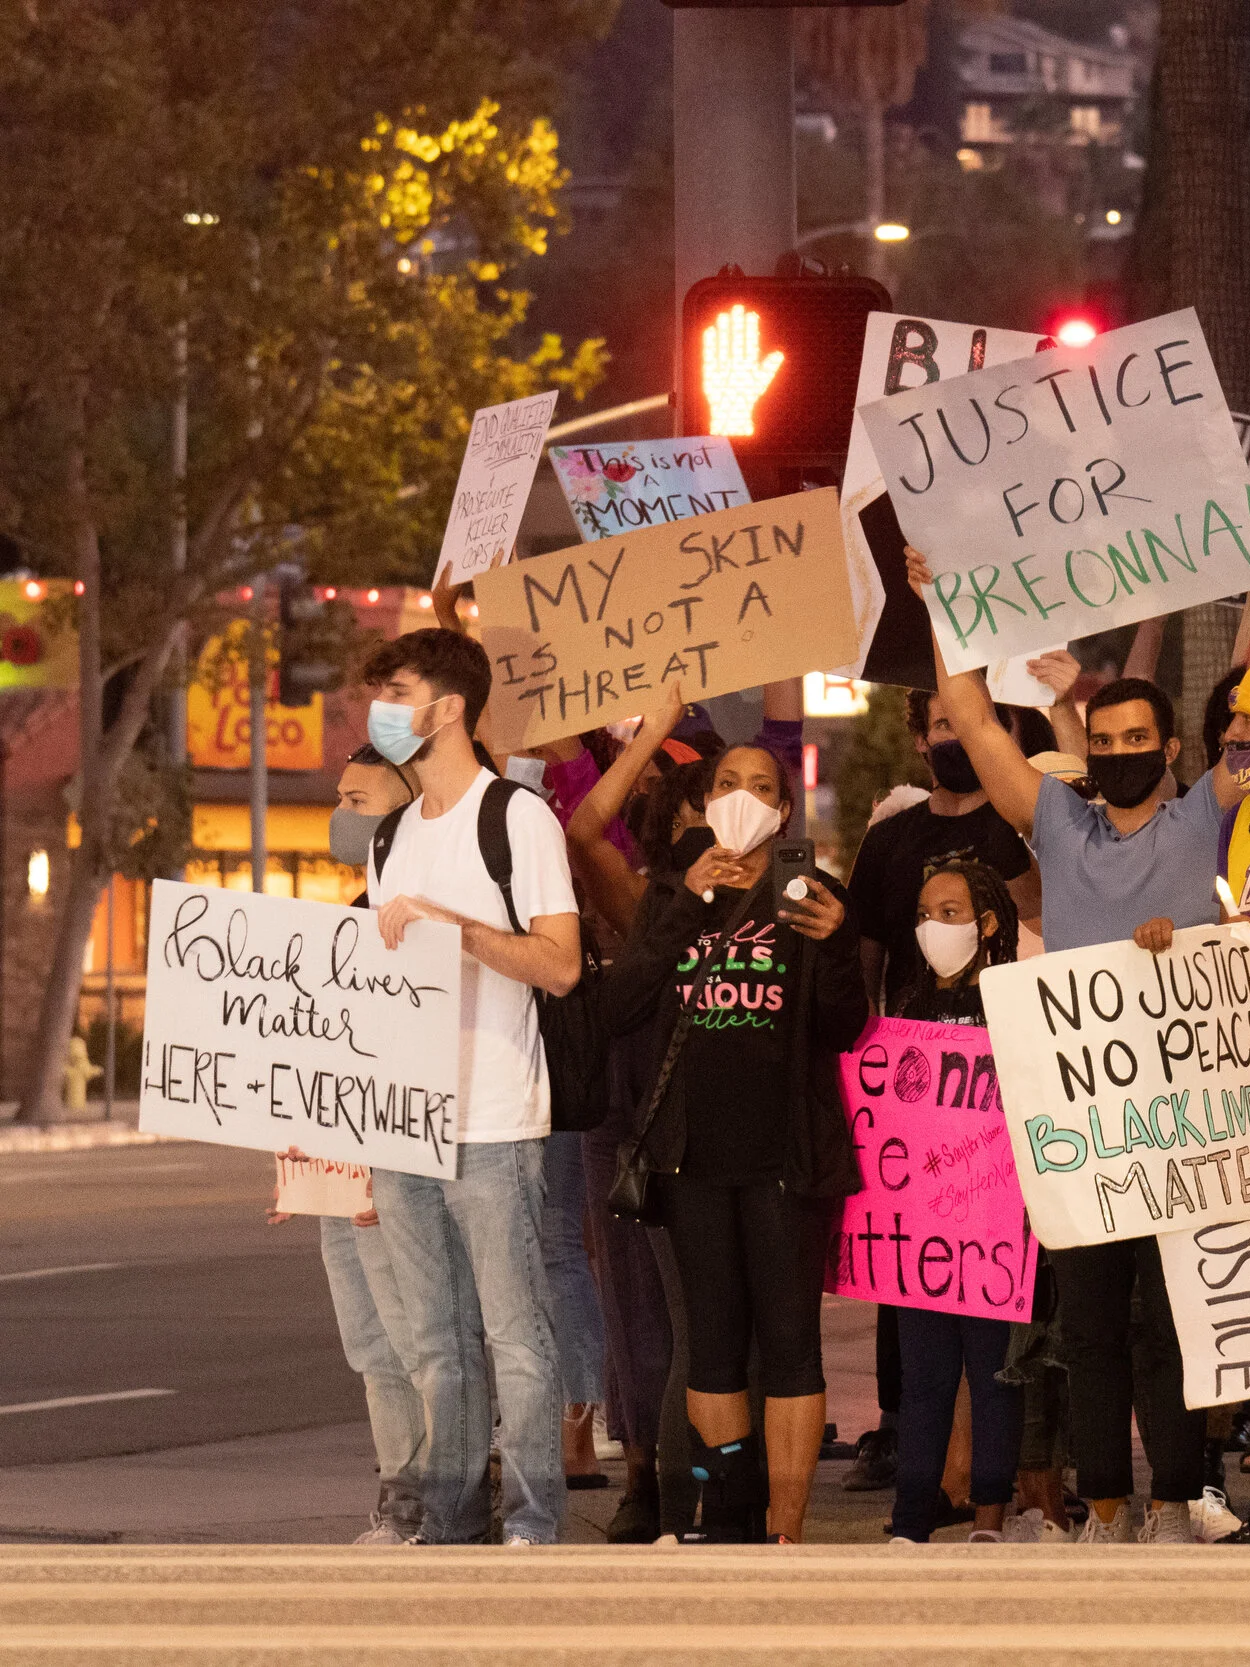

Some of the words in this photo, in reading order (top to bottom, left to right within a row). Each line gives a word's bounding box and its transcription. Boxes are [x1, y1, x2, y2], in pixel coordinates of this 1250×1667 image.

[898, 339, 1203, 494] JUSTICE
[574, 447, 645, 474] This
[650, 452, 671, 471] is
[673, 445, 717, 473] not
[643, 474, 660, 487] A
[1002, 458, 1152, 537] FOR
[465, 512, 509, 545] KILLER
[585, 489, 739, 529] MOMENT
[523, 547, 625, 633] MY
[679, 520, 805, 589] SKIN
[496, 642, 557, 685] IS
[604, 596, 704, 649] NOT
[737, 580, 773, 625] A
[518, 641, 719, 721] THREAT
[1037, 969, 1125, 1036] NO
[144, 1040, 237, 1126] HERE
[270, 1063, 456, 1166] EVERYWHERE
[1056, 1039, 1138, 1102] NO
[1025, 1089, 1207, 1174] BLACK
[830, 1206, 1032, 1313] atters!
